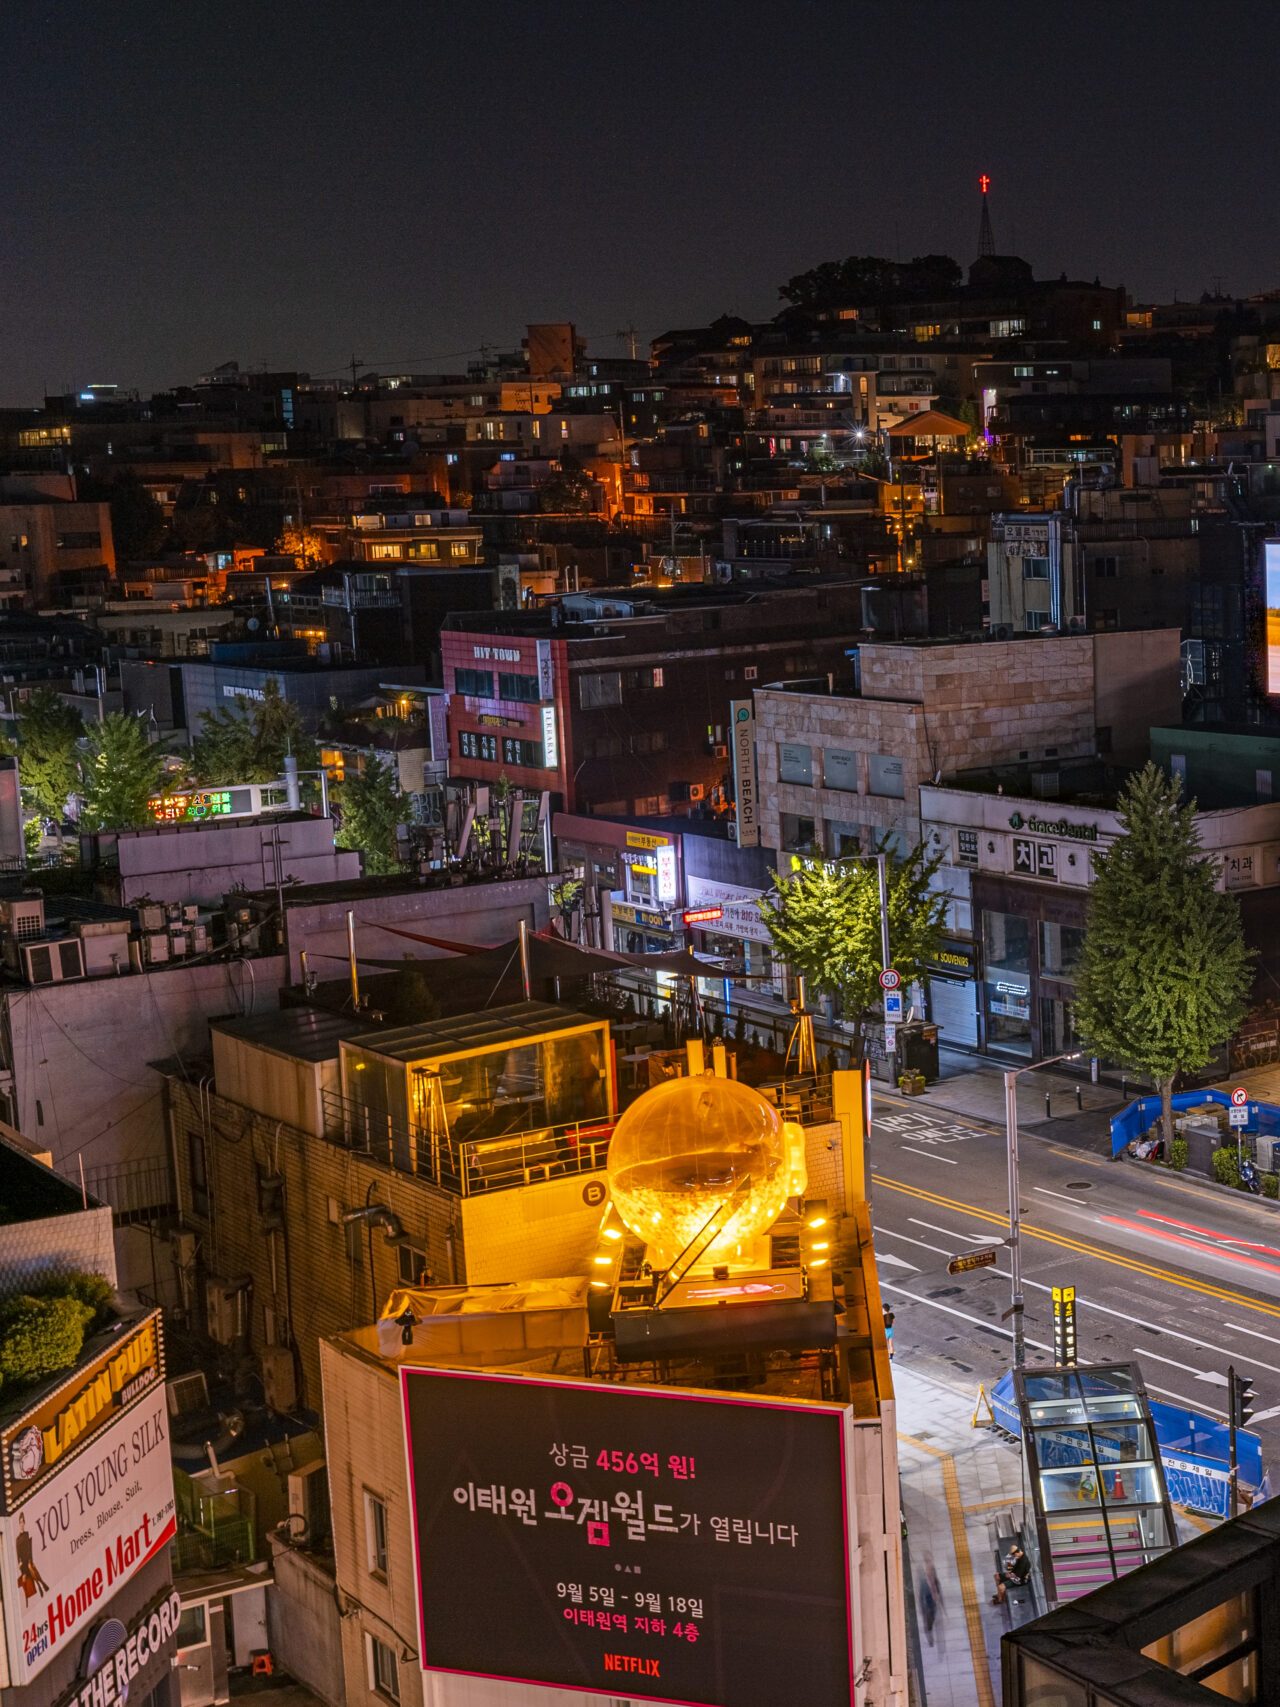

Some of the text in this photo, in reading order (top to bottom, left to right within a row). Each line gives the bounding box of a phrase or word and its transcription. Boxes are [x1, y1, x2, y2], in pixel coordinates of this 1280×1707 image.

[473, 646, 520, 662] HIT TOWN
[740, 728, 753, 825] NORTH BEACH
[1016, 842, 1058, 878] 치과
[1231, 856, 1253, 872] 치과
[641, 911, 663, 926] moon
[940, 953, 969, 968] SOUVENIRS
[884, 974, 896, 985] 50
[587, 1186, 602, 1202] B
[42, 1328, 153, 1465] LATIN PUB
[121, 1366, 156, 1405] BULLDOG
[548, 1442, 696, 1480] 상금 456억 원!
[35, 1408, 165, 1551] YOU YOUNG SILK
[453, 1481, 799, 1548] 이태원 오겜월드가 열립니다
[48, 1567, 104, 1646] Home
[104, 1512, 152, 1587] Mart
[556, 1582, 583, 1604] 9월
[589, 1586, 615, 1607] 5일
[634, 1592, 662, 1614] 9월
[668, 1596, 704, 1619] 18일
[563, 1608, 700, 1643] 이태원역 지하 4층
[27, 1636, 49, 1667] OPEN
[603, 1652, 661, 1678] NETFLIX
